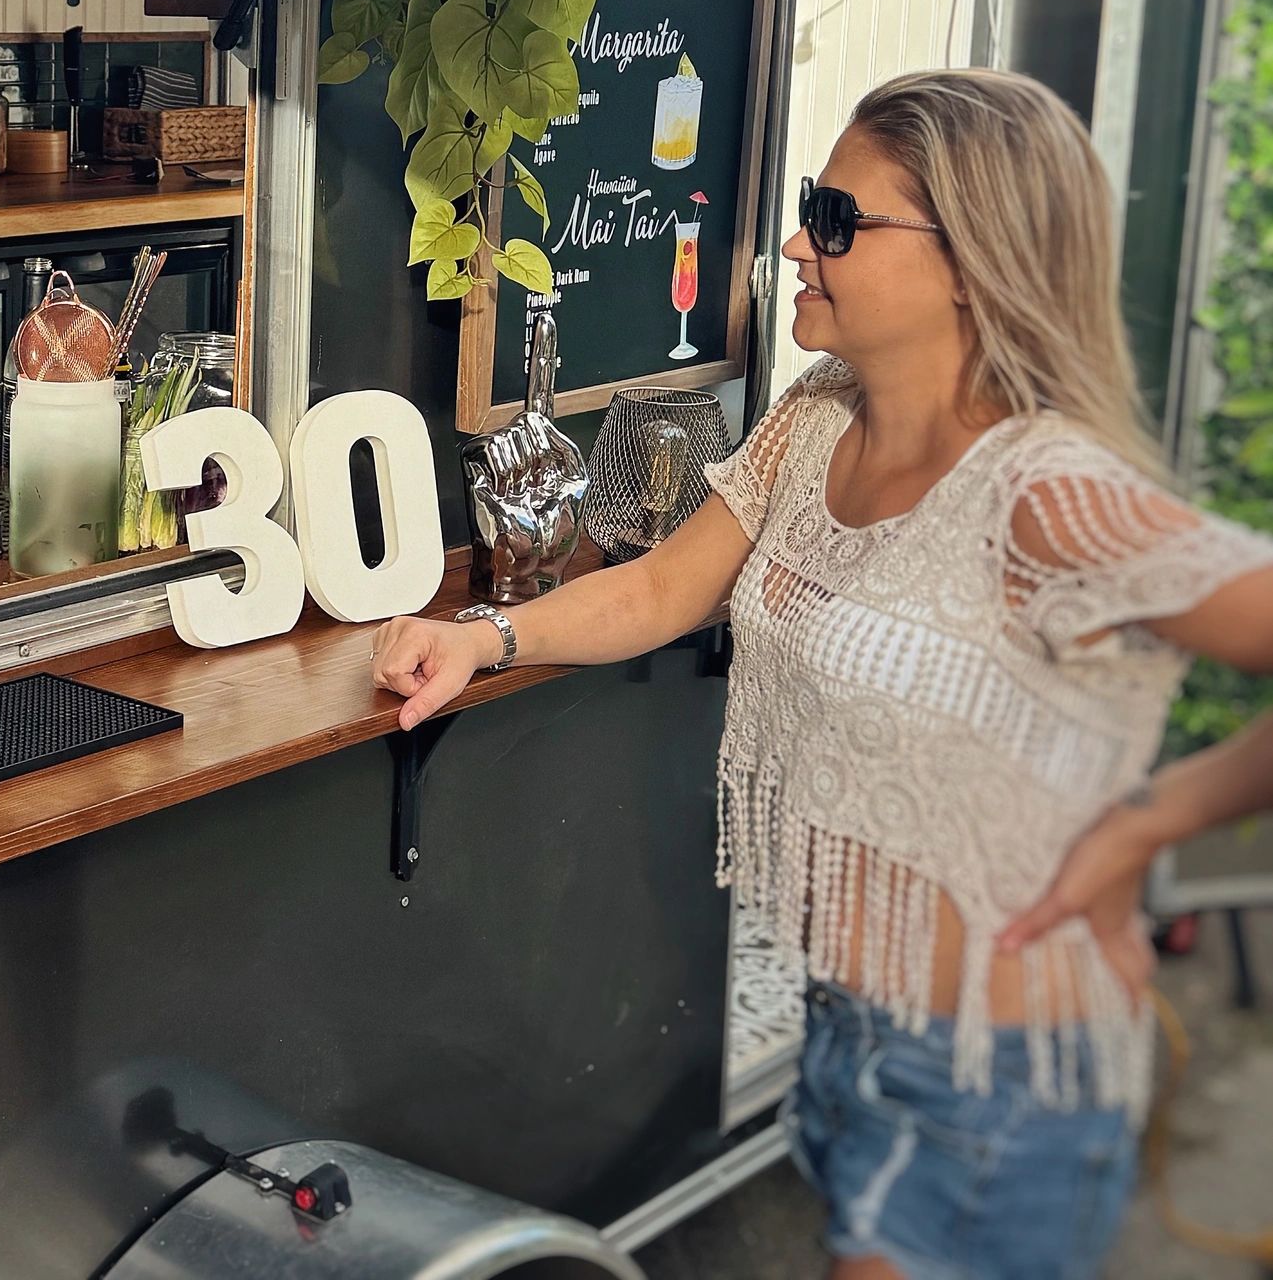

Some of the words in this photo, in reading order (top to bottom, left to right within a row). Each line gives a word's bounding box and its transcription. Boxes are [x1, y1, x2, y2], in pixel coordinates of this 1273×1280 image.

[569, 12, 685, 73] Margarita
[578, 89, 601, 109] equila
[533, 148, 556, 167] Agave
[587, 168, 638, 198] Hawaiian
[551, 193, 617, 254] Mai
[621, 189, 660, 248] Tai
[556, 269, 573, 286] Dark
[138, 389, 445, 650] 30
